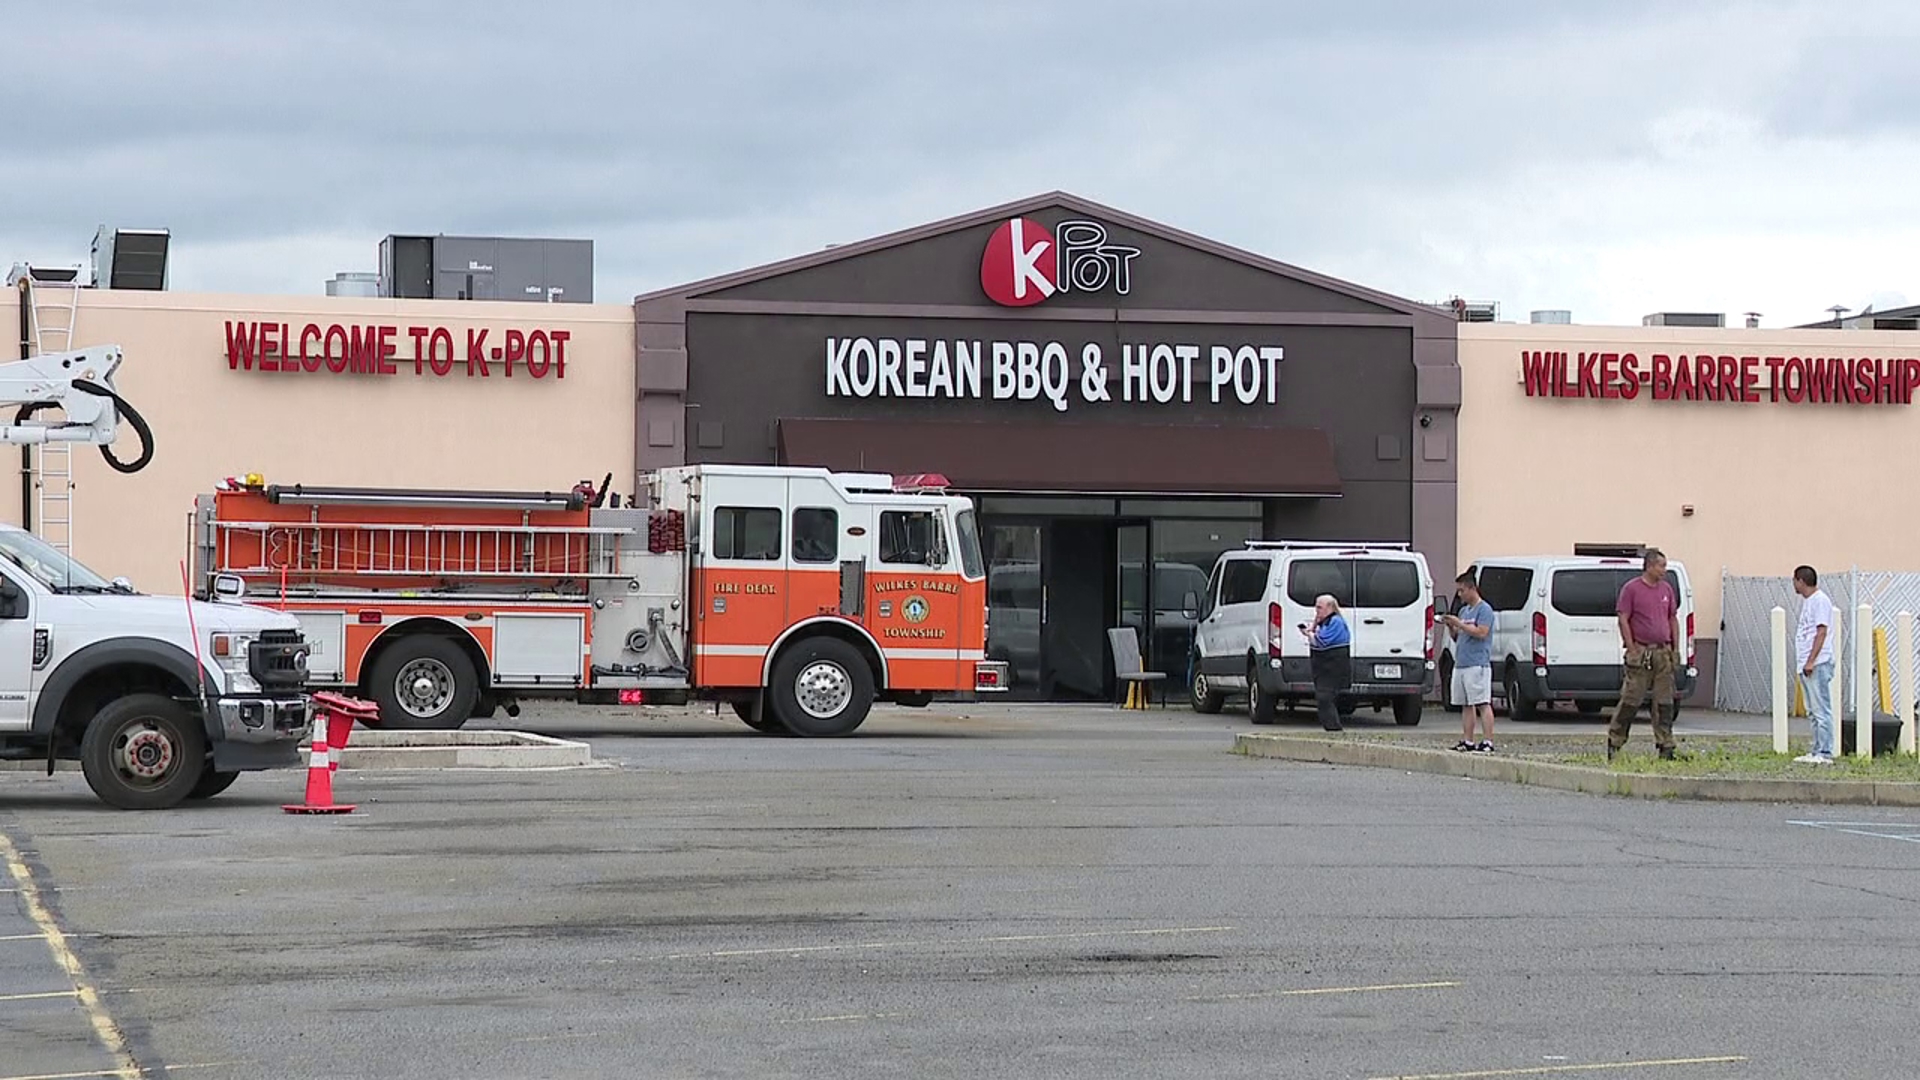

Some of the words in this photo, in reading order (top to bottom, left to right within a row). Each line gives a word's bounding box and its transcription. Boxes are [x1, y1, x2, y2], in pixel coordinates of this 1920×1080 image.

[225, 321, 397, 375] WELCOME
[408, 327, 454, 376] TO
[467, 328, 571, 379] K-POT
[827, 338, 981, 398] KOREAN
[992, 341, 1069, 411] BBQ
[1081, 343, 1112, 402] &
[1123, 344, 1200, 403] HOT
[1211, 345, 1284, 404] POT
[1522, 351, 1760, 402] WILKES-BARRE
[1765, 356, 1920, 404] TOWNSHIP
[714, 583, 740, 594] FIRE
[874, 580, 917, 593] WILKES
[922, 580, 959, 594] BARRE
[884, 627, 946, 639] TOWNSHIP
